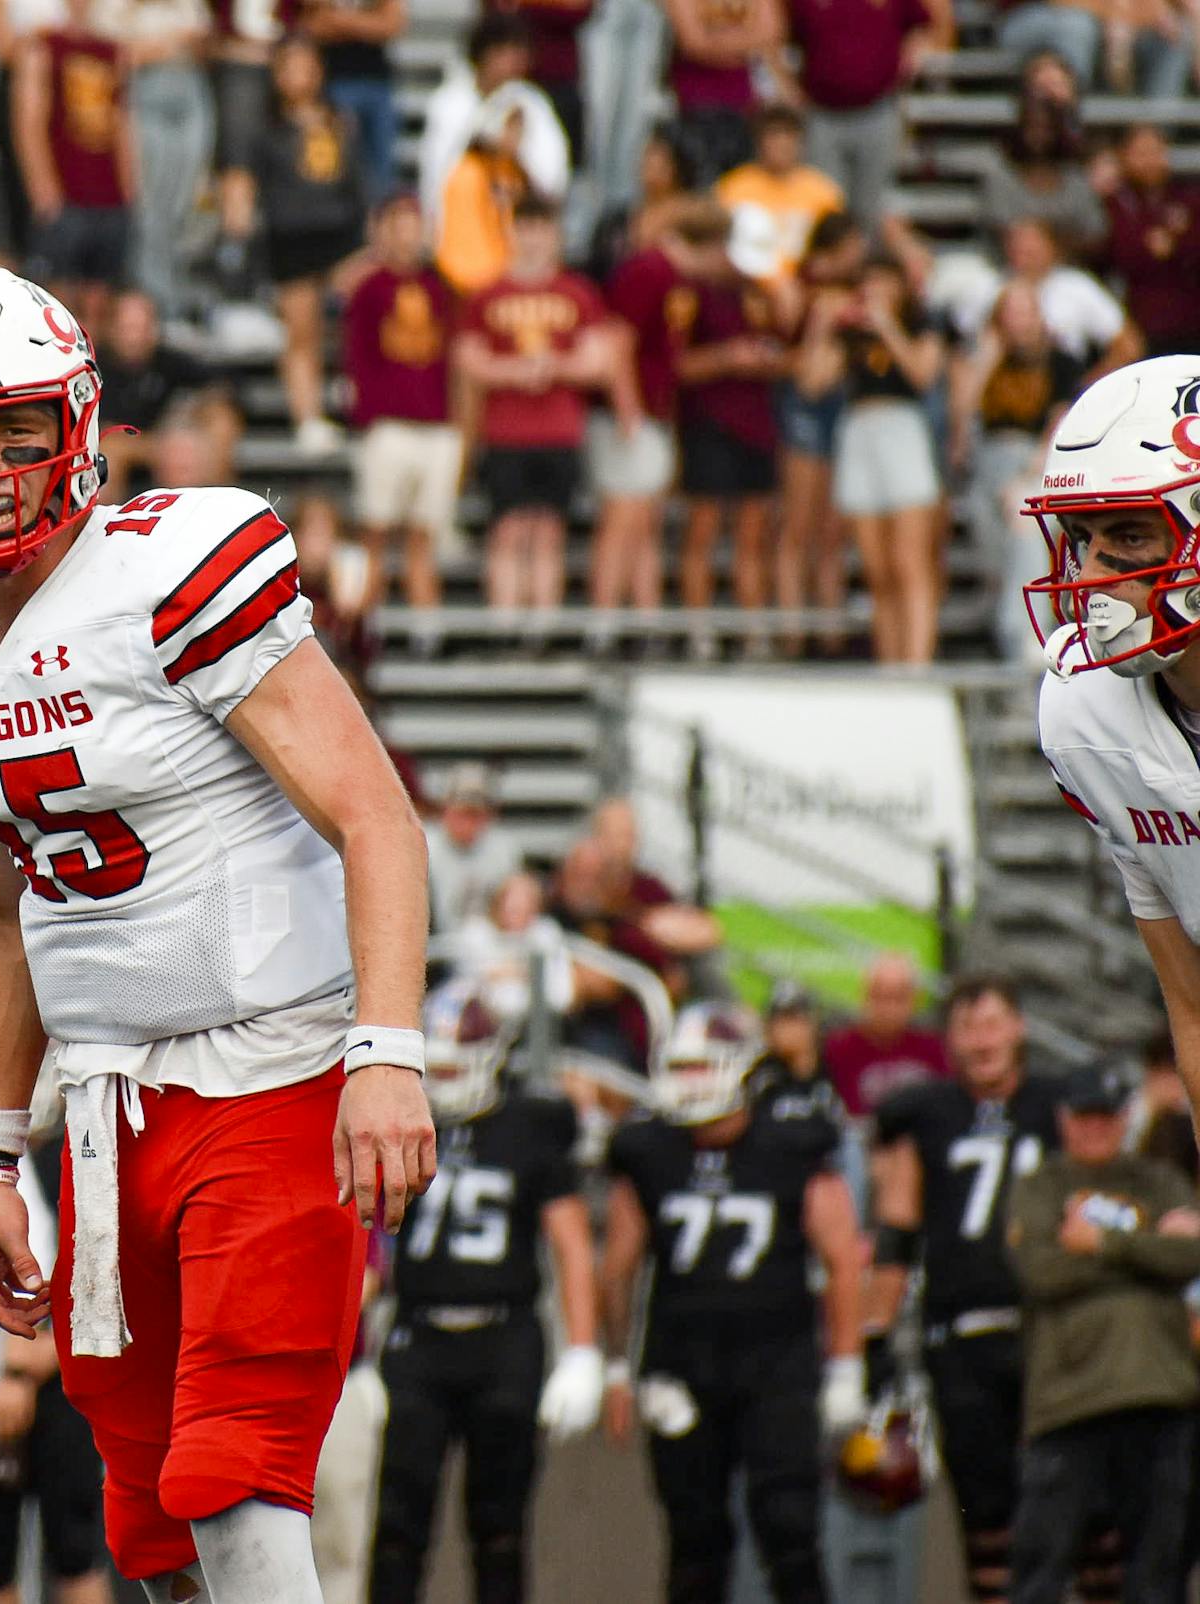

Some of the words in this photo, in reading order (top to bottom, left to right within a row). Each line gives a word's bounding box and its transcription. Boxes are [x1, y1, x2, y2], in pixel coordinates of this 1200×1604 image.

[1043, 473, 1085, 489] Riddell
[105, 494, 181, 536] 15
[1126, 807, 1200, 846] DRA
[406, 1165, 513, 1264] 75
[659, 1191, 775, 1281] 77
